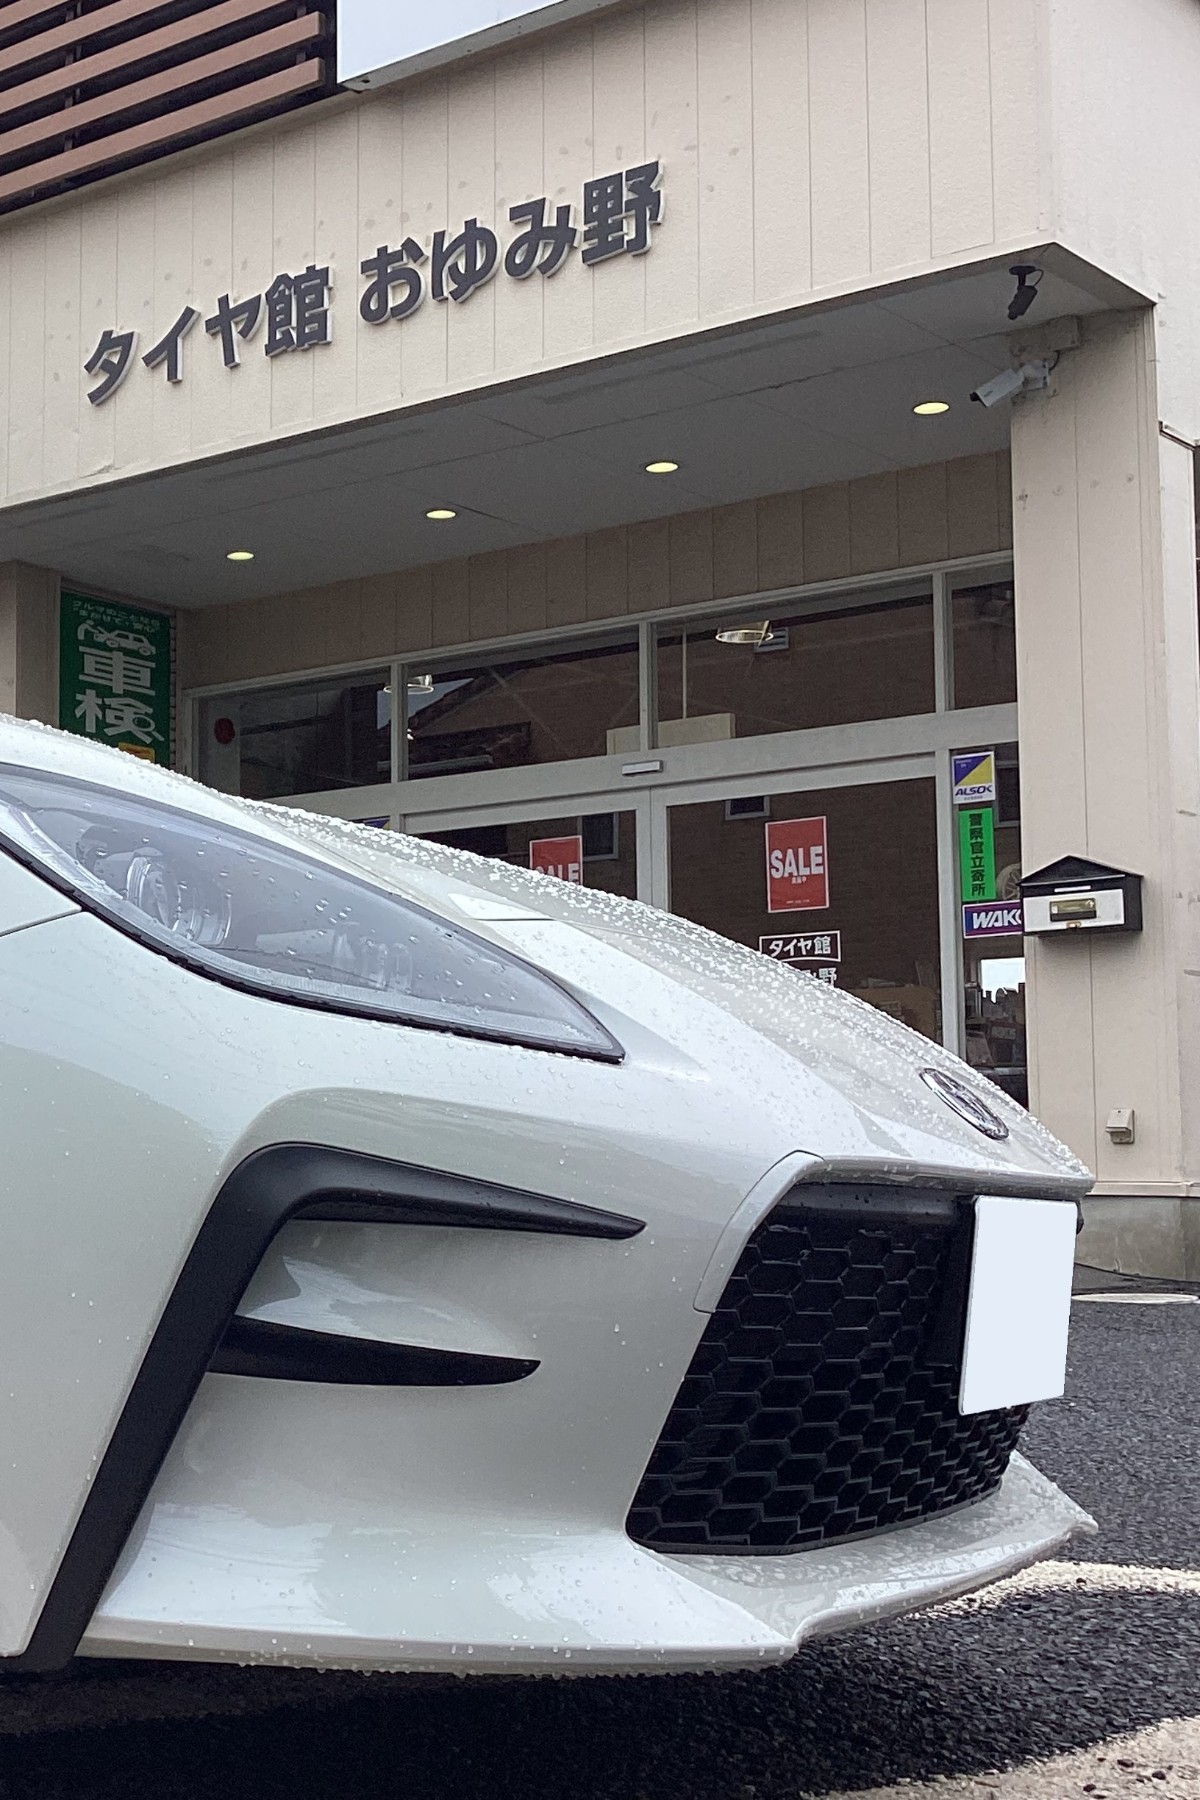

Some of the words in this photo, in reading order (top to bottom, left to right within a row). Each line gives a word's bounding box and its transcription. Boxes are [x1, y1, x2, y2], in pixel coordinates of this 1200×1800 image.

[84, 265, 333, 404] タイヤ館
[359, 160, 663, 325] おゆみ野
[75, 646, 164, 744] 車検
[955, 785, 993, 796] ALSOK
[770, 845, 824, 879] SALE
[969, 813, 985, 897] 警察官立寄所
[972, 909, 1021, 929] WAK
[769, 936, 831, 957] タイヤ館
